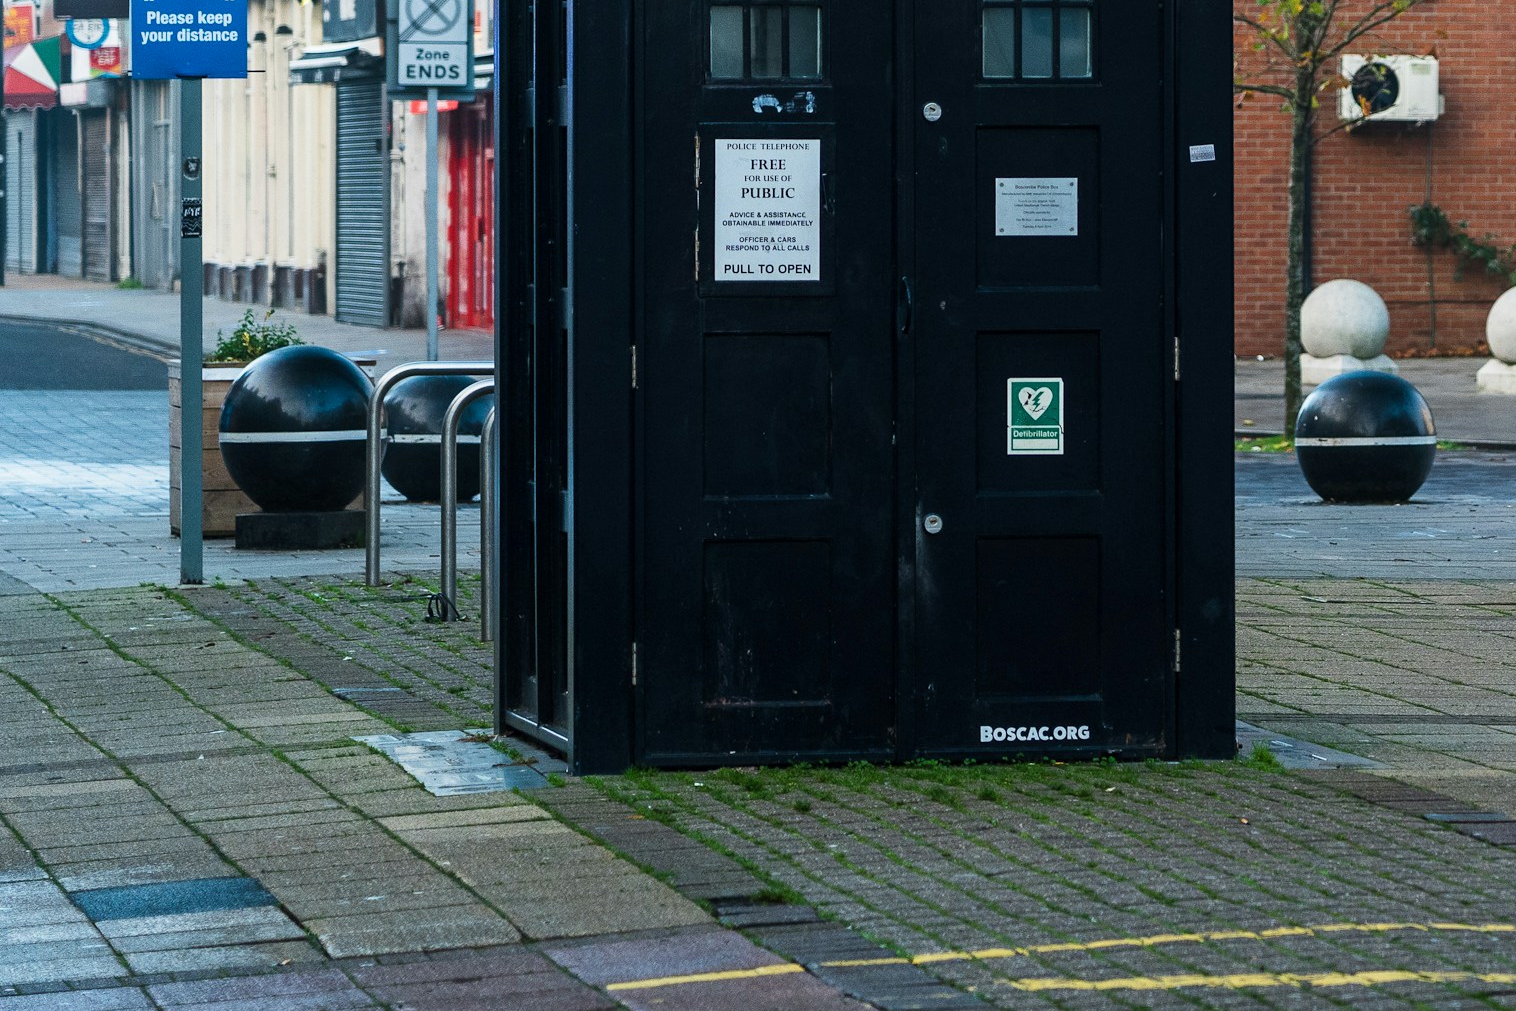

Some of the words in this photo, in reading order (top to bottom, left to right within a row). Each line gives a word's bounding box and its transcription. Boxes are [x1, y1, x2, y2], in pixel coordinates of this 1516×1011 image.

[146, 11, 193, 24] Please
[197, 10, 233, 27] keep
[141, 30, 174, 45] your
[177, 28, 238, 42] distance
[416, 48, 450, 60] Zone
[406, 65, 460, 80] ENDS
[750, 159, 786, 170] FREE
[740, 187, 796, 199] PUBLIC
[724, 264, 755, 274] PULL
[758, 264, 775, 274] TO
[778, 264, 812, 274] OPEN
[1013, 429, 1058, 438] Defibrillator
[980, 725, 1090, 743] BOSCAC.ORG
